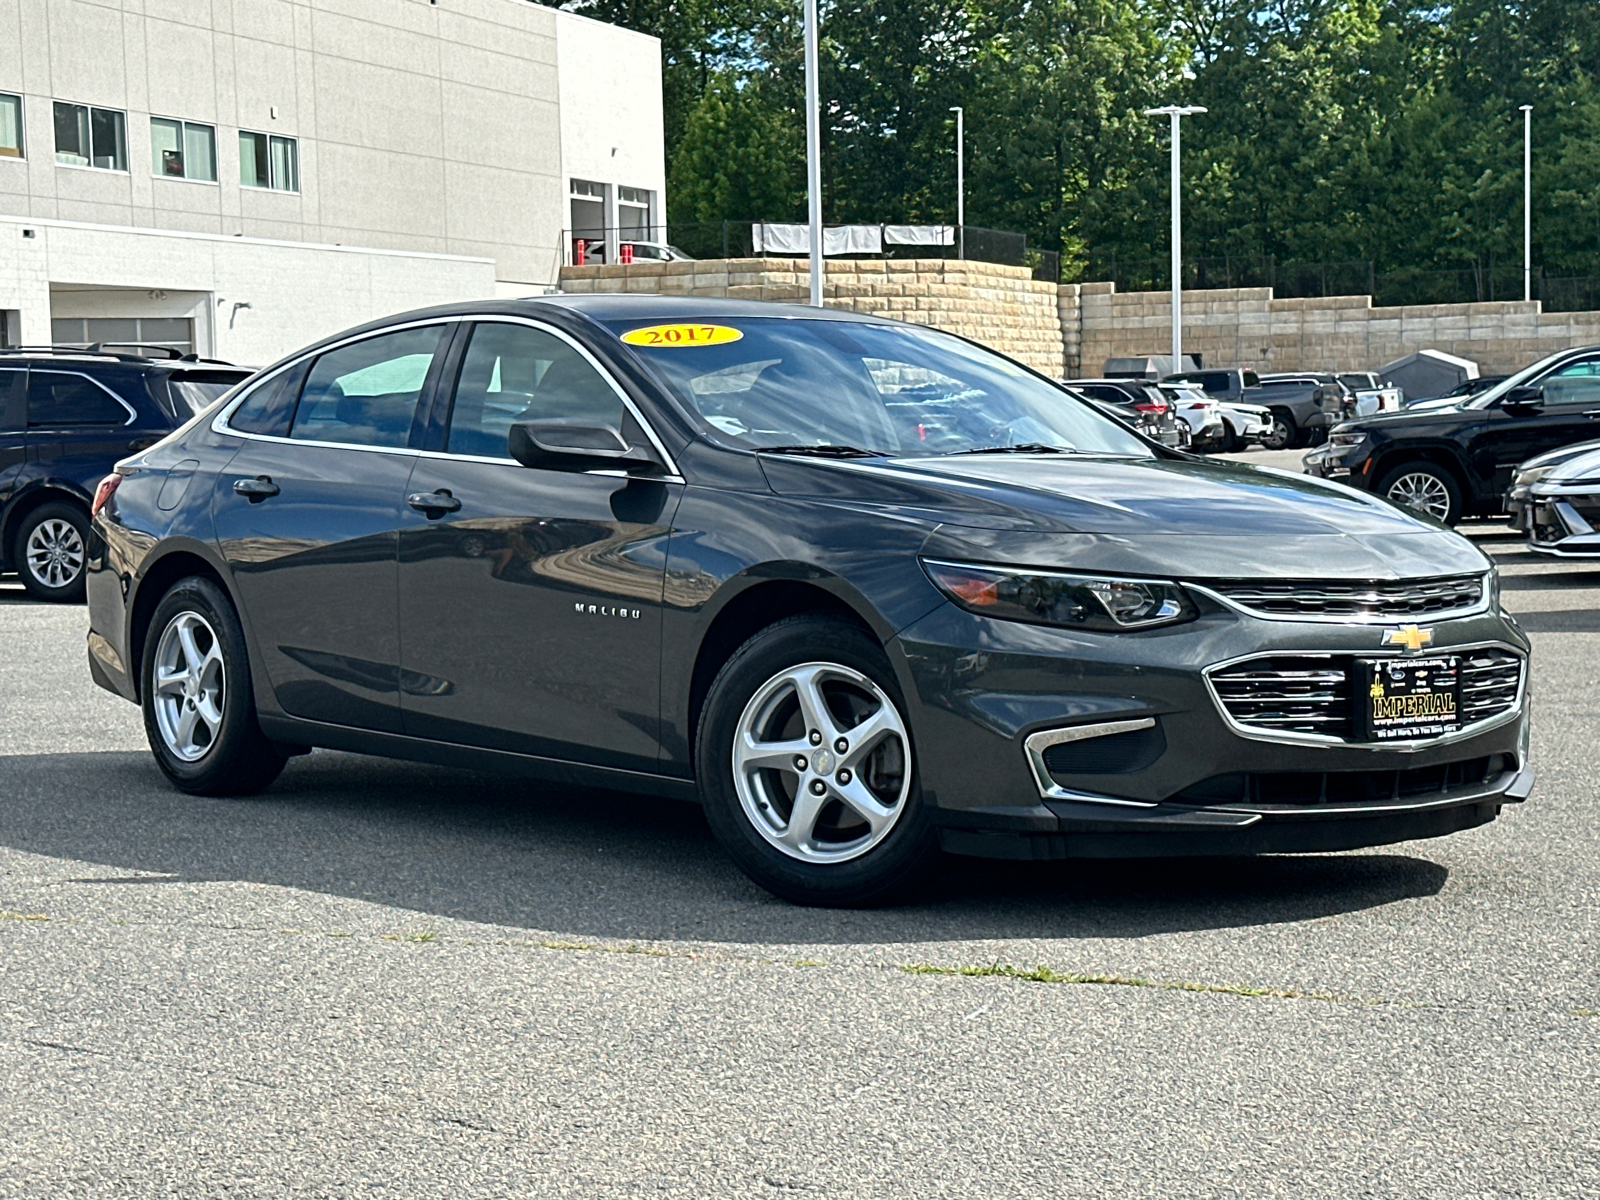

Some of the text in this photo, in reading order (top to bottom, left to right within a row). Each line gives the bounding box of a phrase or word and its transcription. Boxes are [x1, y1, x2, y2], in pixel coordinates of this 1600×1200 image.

[645, 327, 715, 344] 2017
[575, 603, 640, 619] MALIBU
[1373, 693, 1456, 718] IMPERIAL
[1373, 714, 1456, 726] www.imperialcars.com
[1377, 729, 1386, 738] We
